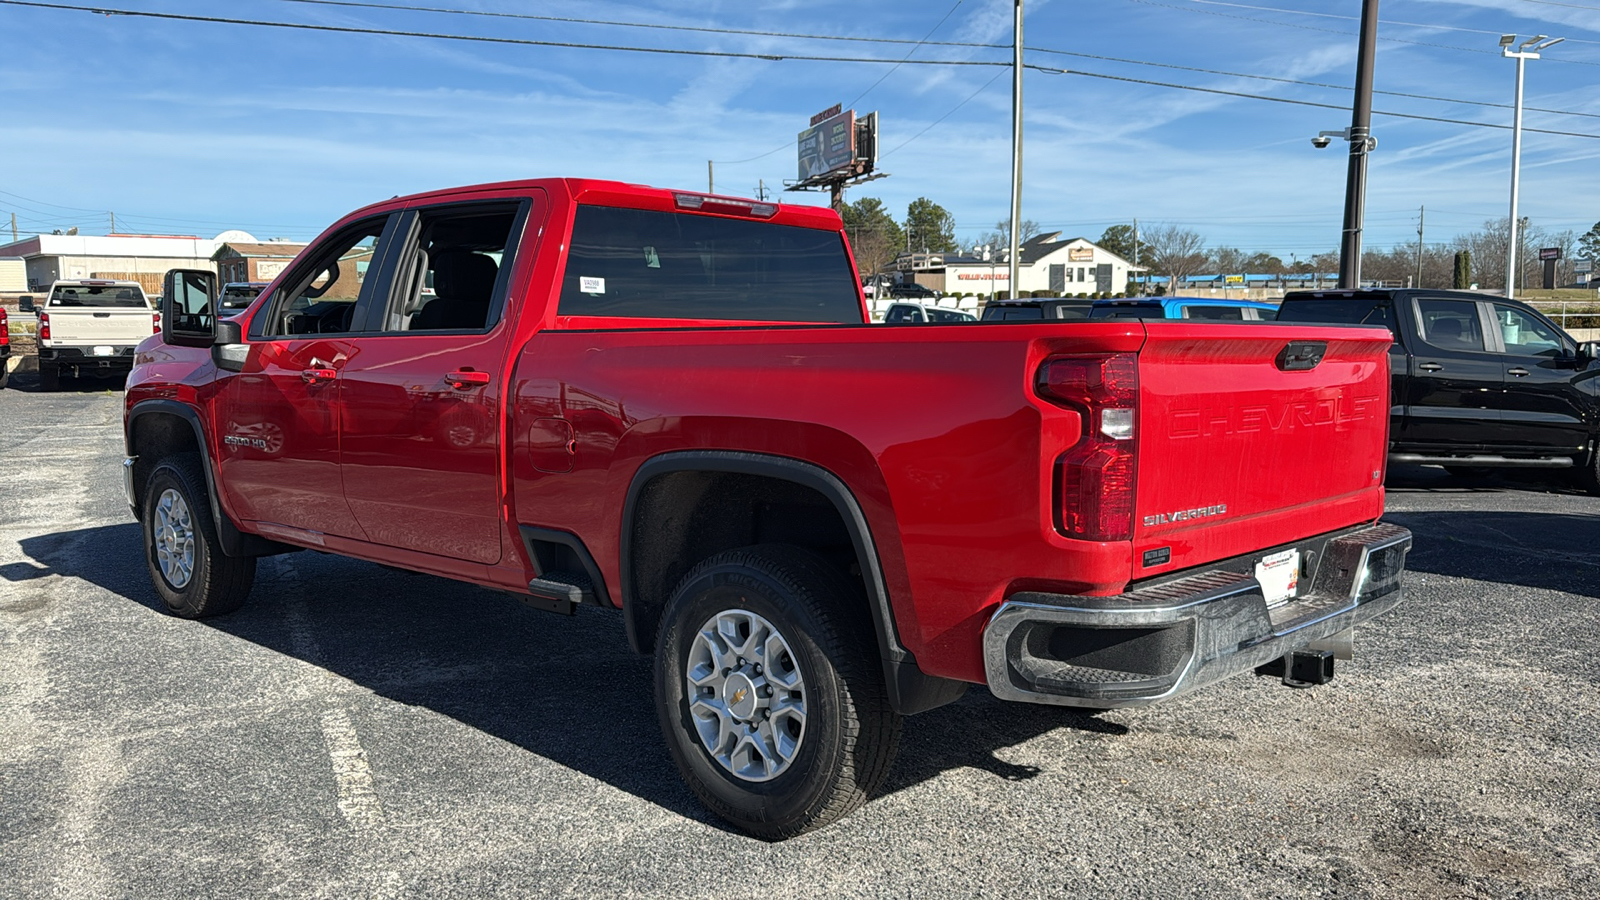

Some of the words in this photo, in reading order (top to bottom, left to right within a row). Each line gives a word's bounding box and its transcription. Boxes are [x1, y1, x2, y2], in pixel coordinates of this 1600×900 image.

[56, 320, 147, 328] CHEVROLET
[1168, 395, 1379, 439] CHEVROLET
[224, 435, 250, 446] 2500
[251, 438, 266, 448] HD
[1143, 504, 1227, 527] SILVERADO
